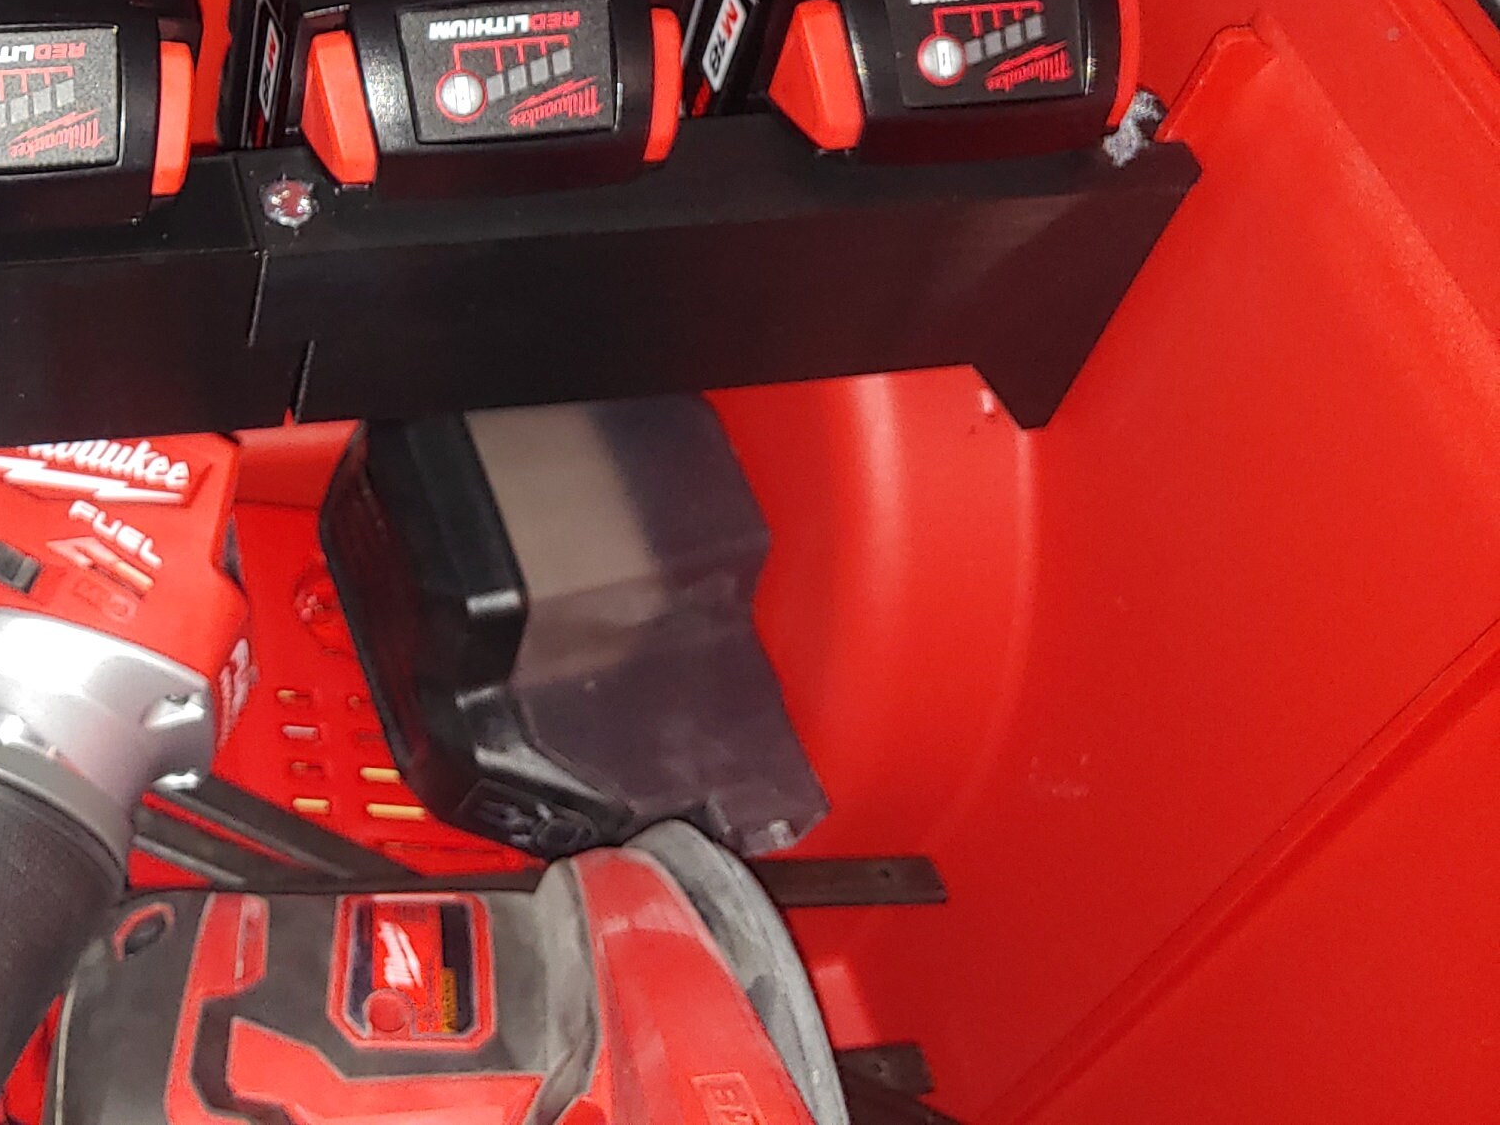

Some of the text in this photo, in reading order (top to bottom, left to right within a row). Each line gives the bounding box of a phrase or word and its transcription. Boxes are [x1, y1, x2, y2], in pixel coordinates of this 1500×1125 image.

[428, 10, 581, 41] REDLITHIUM
[709, 0, 741, 78] M18
[506, 84, 605, 130] Milwaukee
[7, 116, 106, 160] Milwaukee
[68, 499, 164, 570] FUEL
